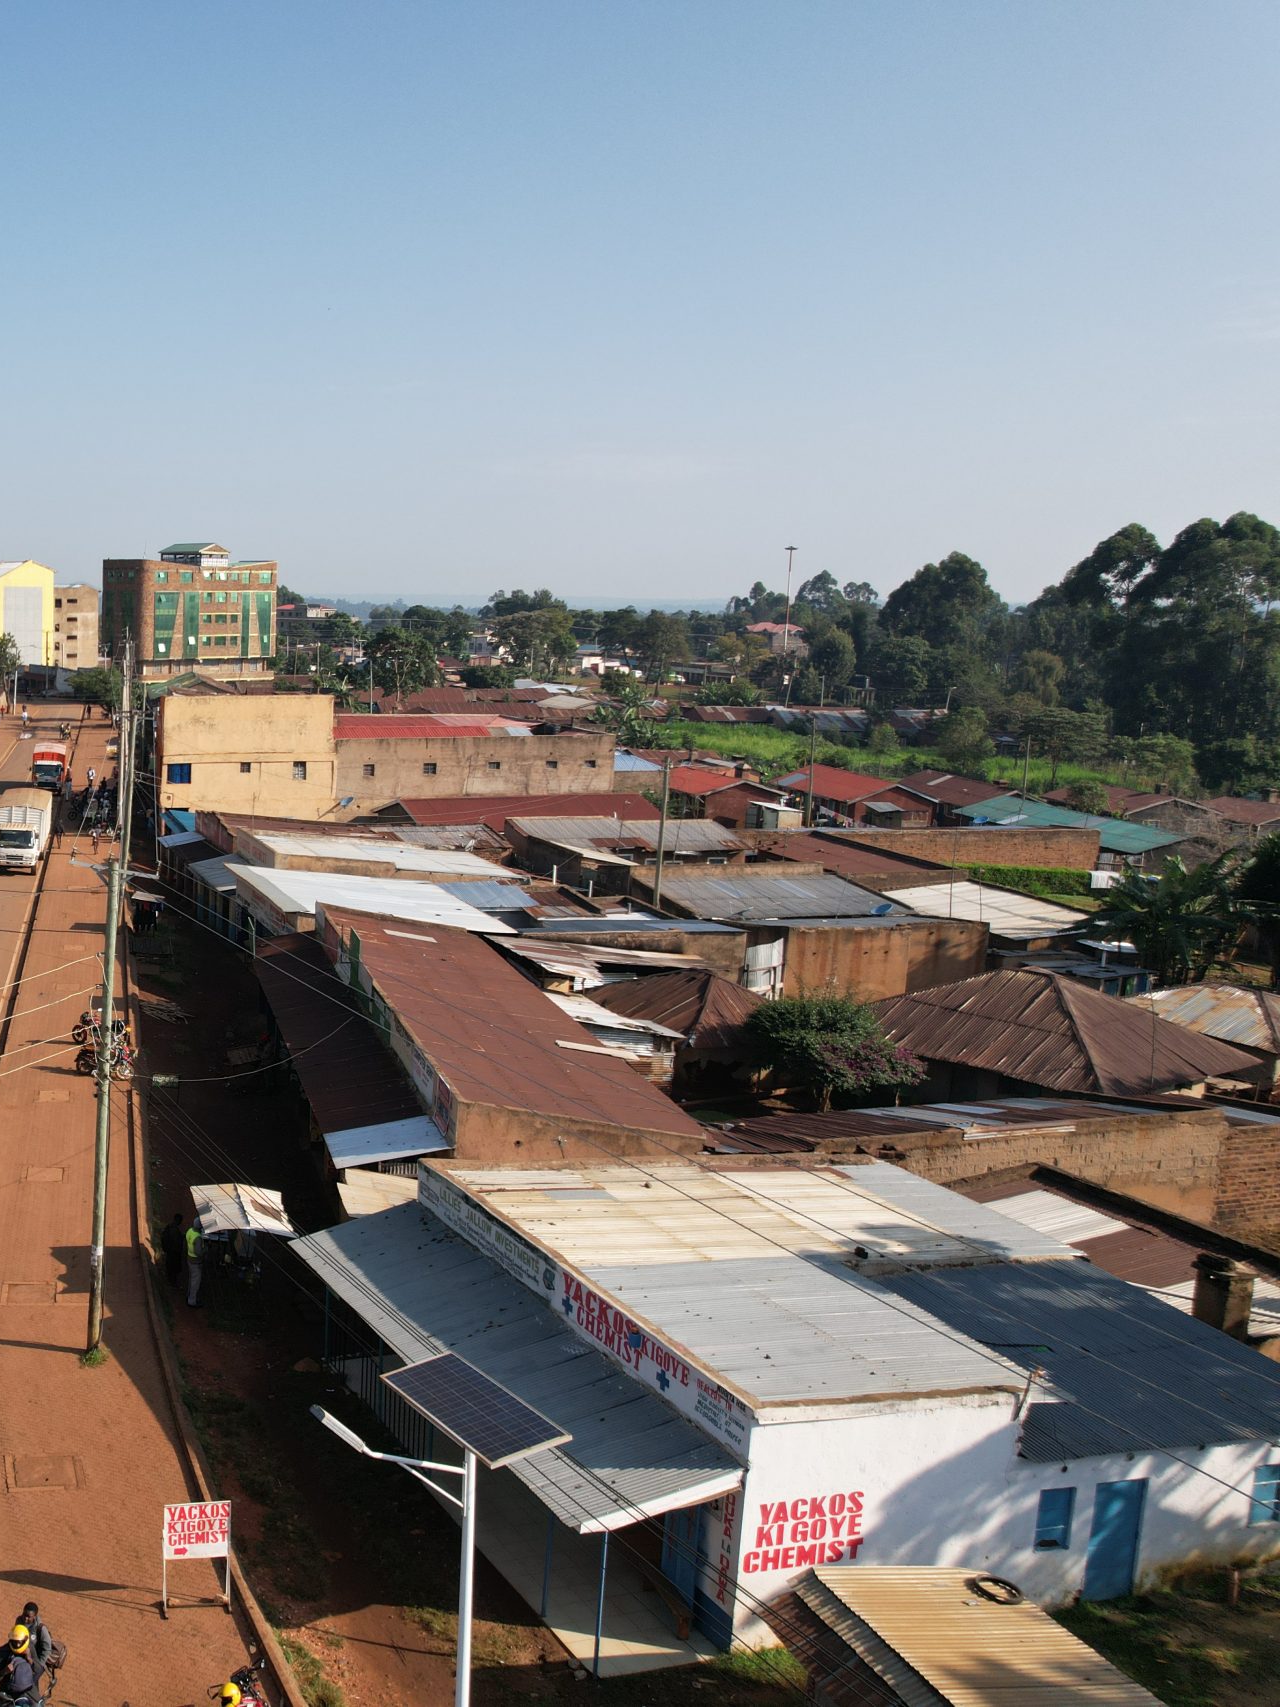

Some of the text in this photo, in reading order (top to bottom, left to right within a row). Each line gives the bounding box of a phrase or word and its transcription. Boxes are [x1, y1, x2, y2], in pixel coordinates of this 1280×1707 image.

[465, 1208, 492, 1235] JALLOW
[494, 1231, 540, 1274] INVESTMENTS
[576, 1305, 643, 1372] CHEMIST
[640, 1333, 690, 1388] KIGOYE
[167, 1503, 230, 1521] YACKOS
[167, 1518, 227, 1534] KIGOYE
[759, 1491, 865, 1526] YACKOS
[168, 1531, 228, 1546] CHEMIST
[742, 1537, 864, 1574] CHEMIST
